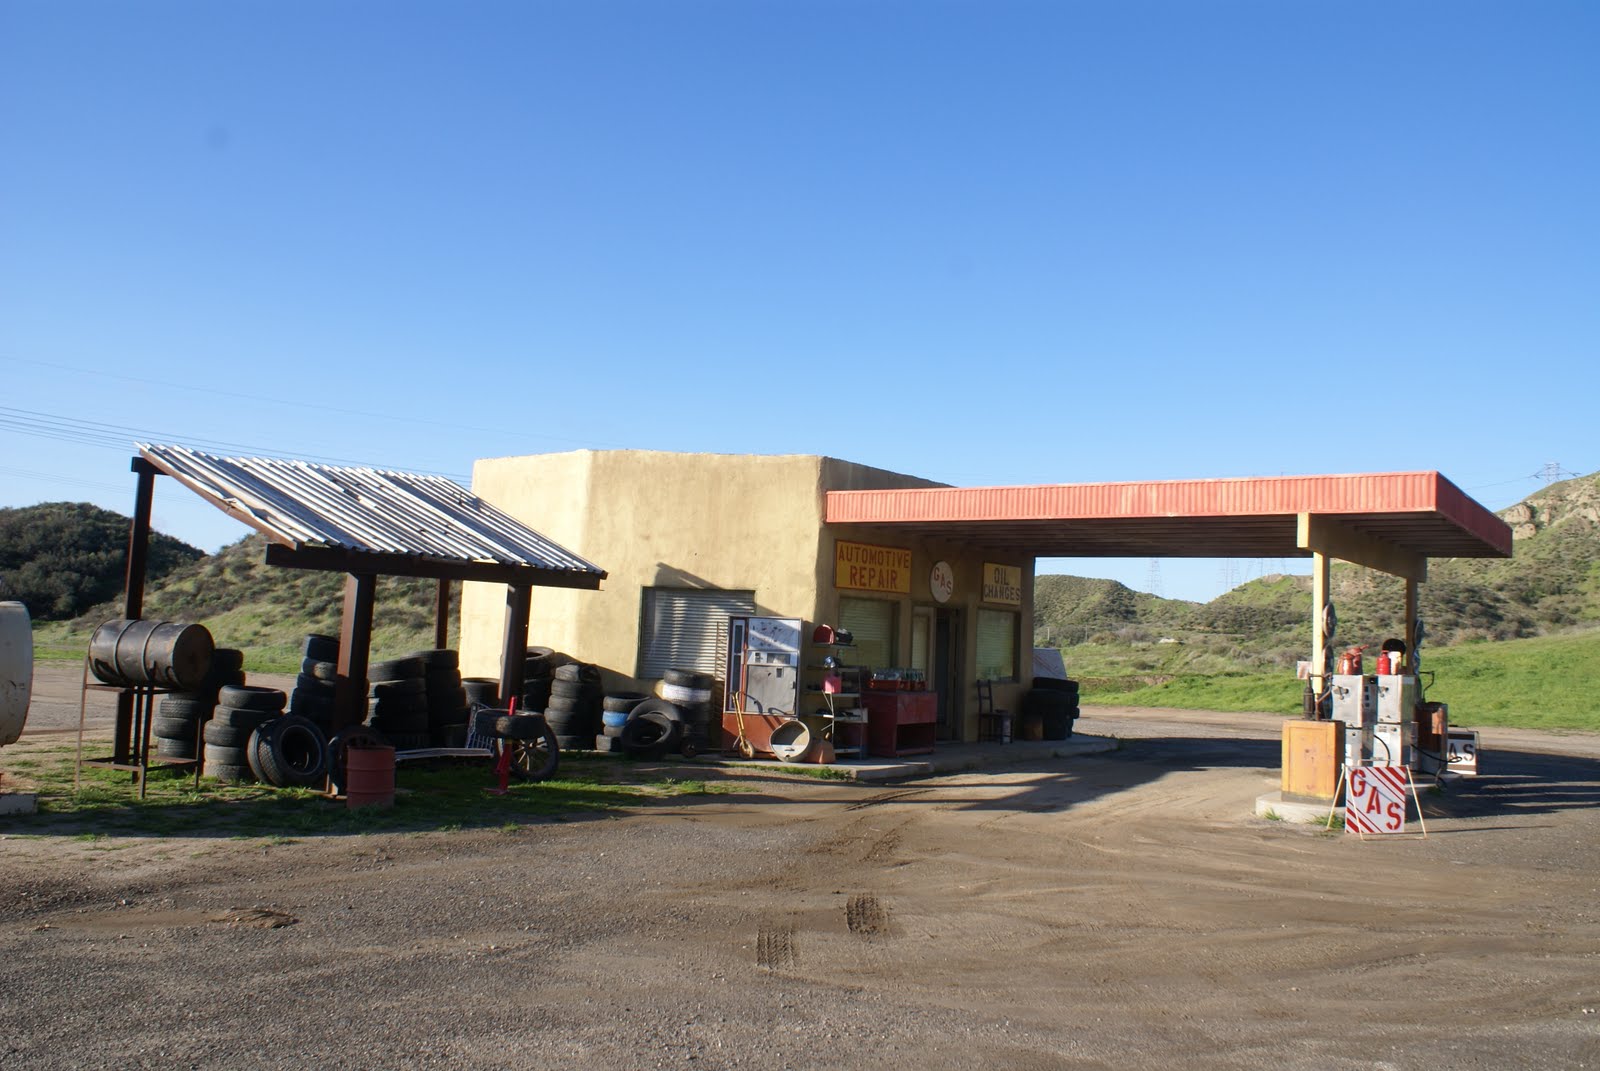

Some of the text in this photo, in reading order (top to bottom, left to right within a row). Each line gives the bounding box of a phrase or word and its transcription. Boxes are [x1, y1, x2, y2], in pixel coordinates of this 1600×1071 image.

[838, 543, 909, 568] AUTOMOTIVE
[849, 565, 897, 589] REPAIR
[933, 566, 952, 595] GAS
[994, 567, 1009, 585] OIL
[984, 584, 1020, 600] CHANGES
[1448, 742, 1474, 762] AS
[1350, 768, 1402, 830] GAS
